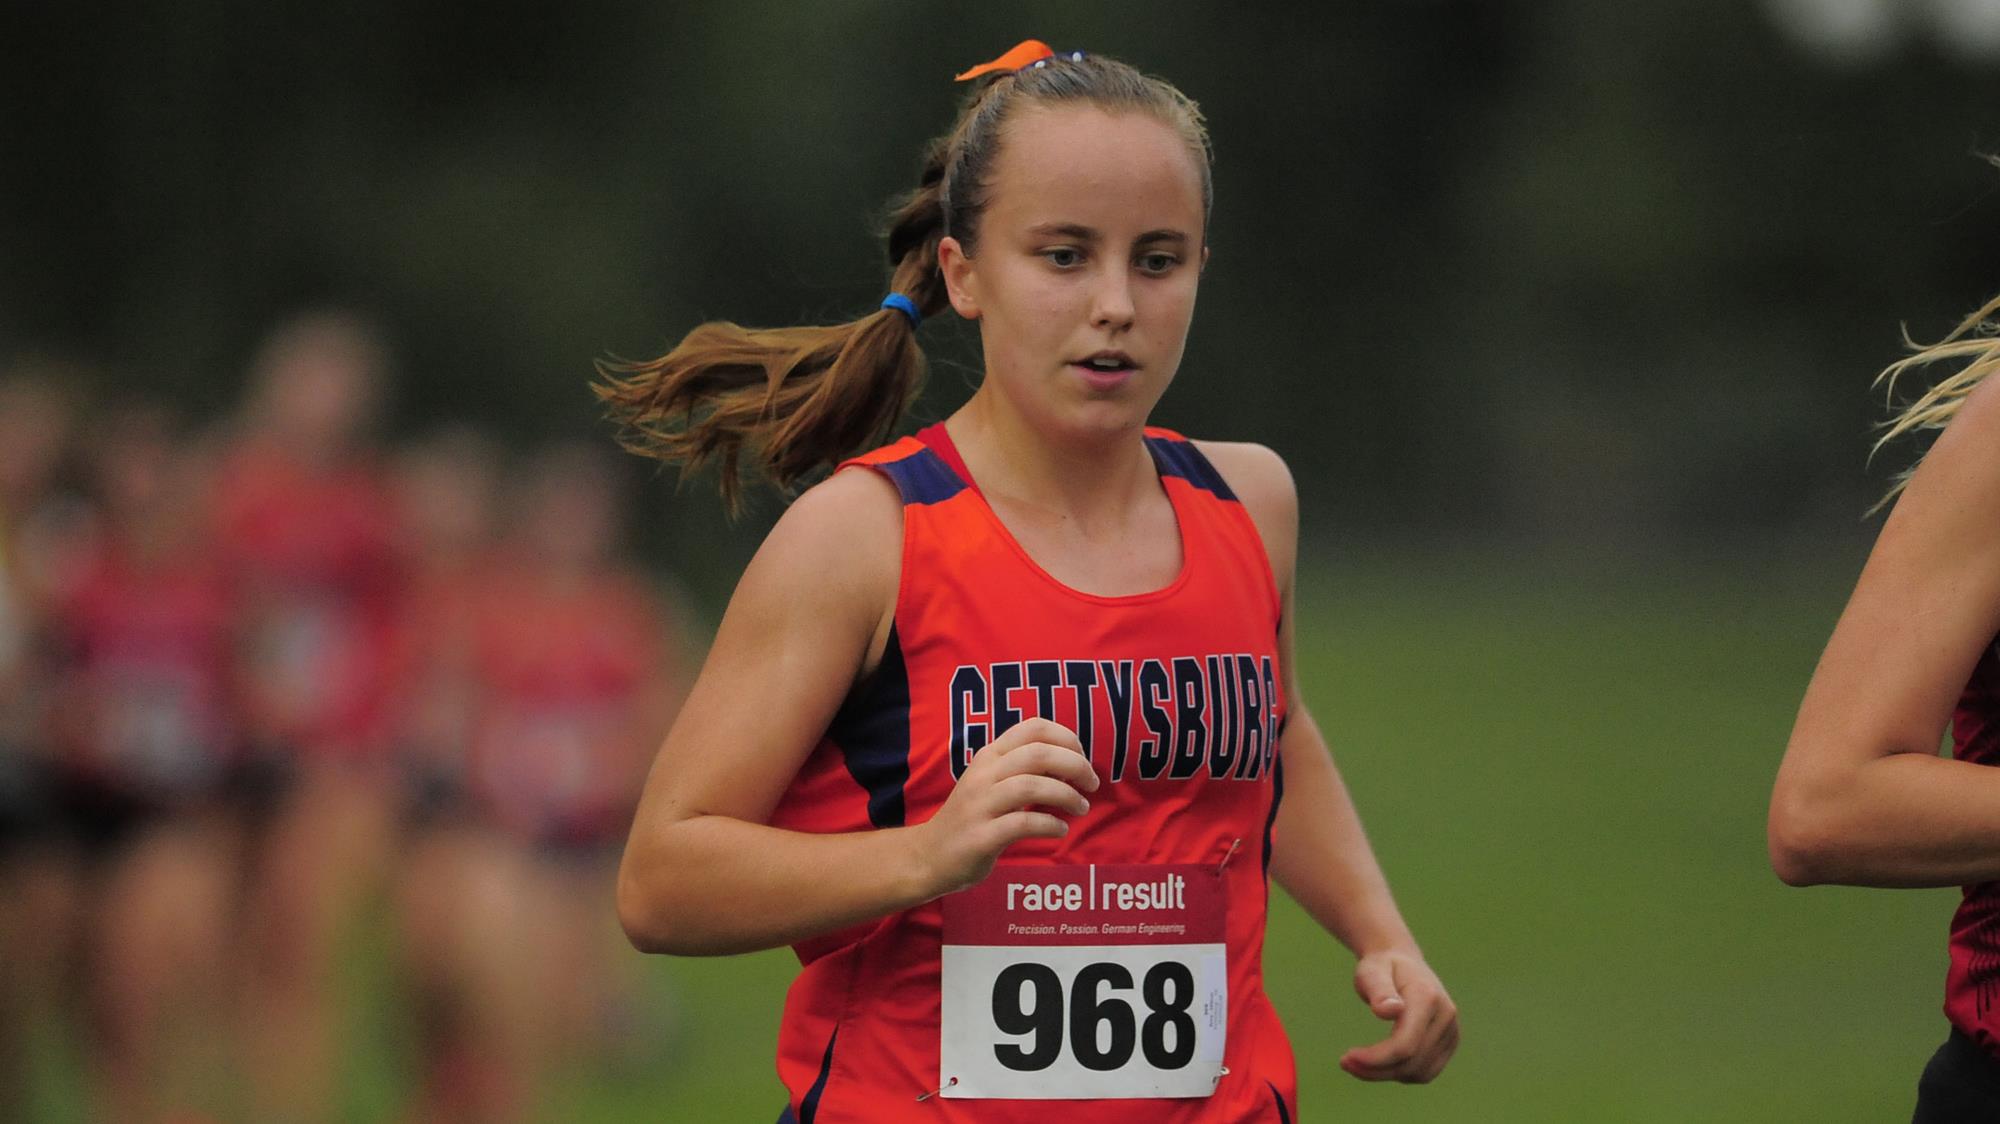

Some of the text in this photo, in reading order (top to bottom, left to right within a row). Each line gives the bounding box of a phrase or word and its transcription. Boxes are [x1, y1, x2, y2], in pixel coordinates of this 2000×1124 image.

[1007, 873, 1186, 911] race result
[1007, 923, 1057, 935] Precision.
[1059, 923, 1099, 935] Passion.
[1101, 923, 1137, 934] German
[991, 960, 1197, 1072] 968
